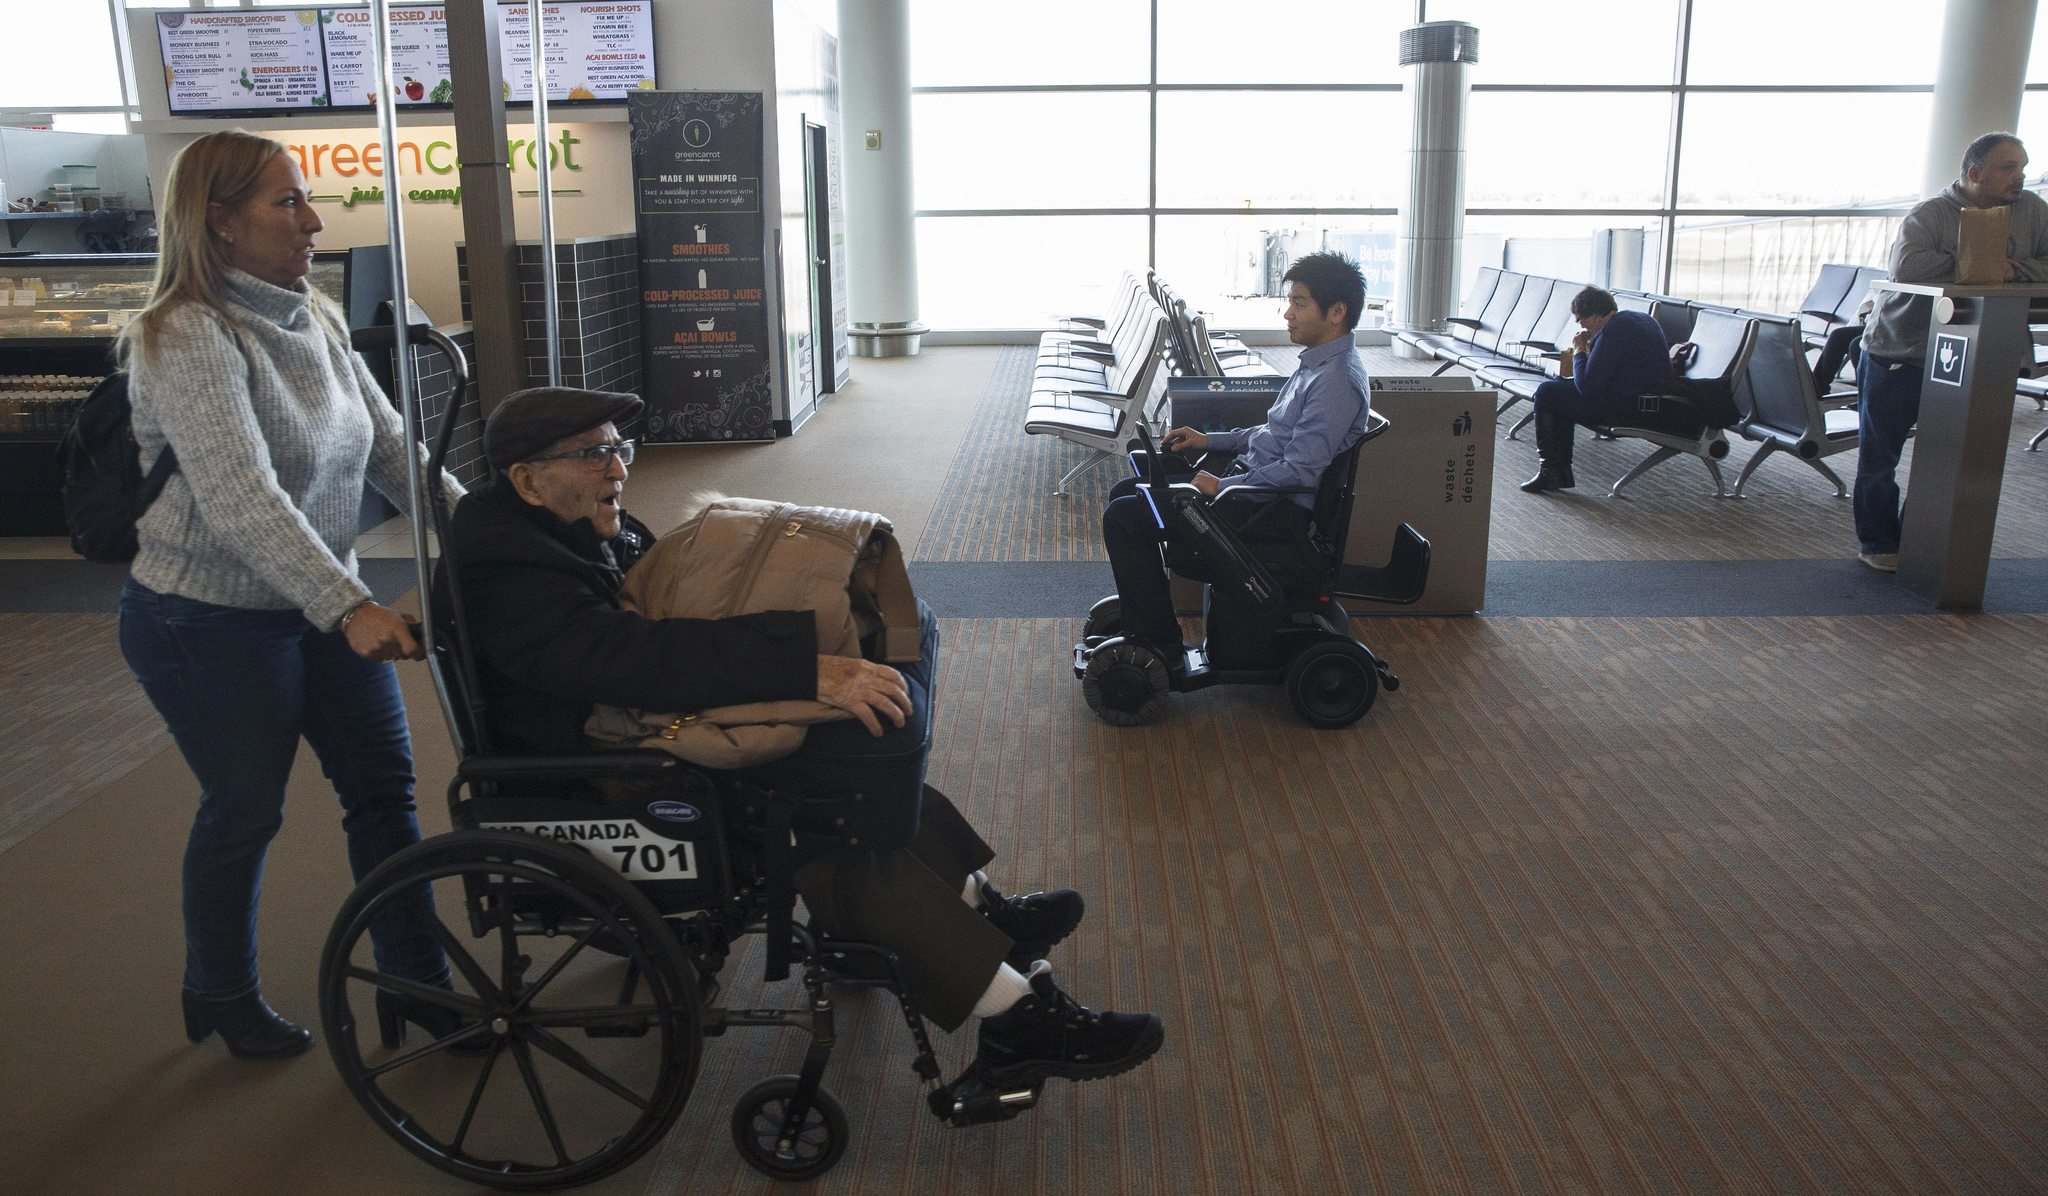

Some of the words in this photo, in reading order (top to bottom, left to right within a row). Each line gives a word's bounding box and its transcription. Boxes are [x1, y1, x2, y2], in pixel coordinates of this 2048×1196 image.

[190, 15, 243, 25] HANDCRAFTED
[245, 15, 287, 23] SMOOTHIES
[252, 66, 301, 74] ENERGIZERS
[674, 151, 721, 160] greencarrot
[659, 174, 683, 183] MADE
[685, 173, 695, 183] IN
[697, 174, 738, 183] WINNIPEG
[671, 243, 731, 256] SMOOTHIES
[643, 289, 730, 301] COLD-PROCESSED
[733, 288, 762, 299] JUICE
[701, 331, 737, 343] BOWLS
[1462, 444, 1476, 504] déchets
[1444, 458, 1456, 503] waste
[612, 843, 689, 874] 701
